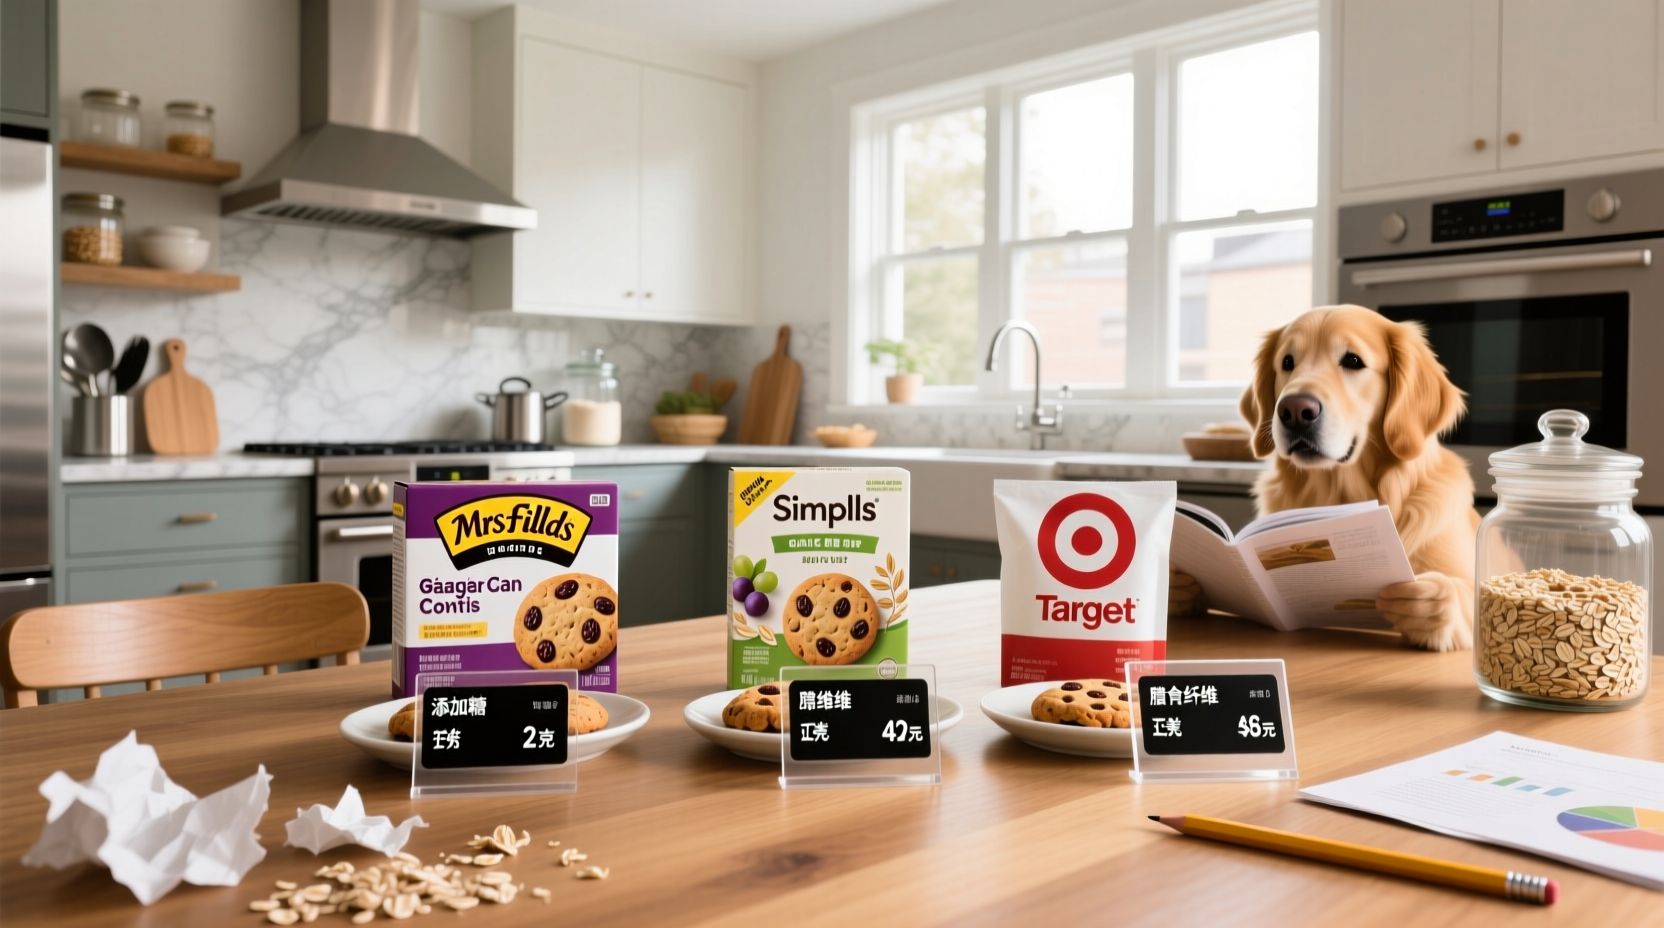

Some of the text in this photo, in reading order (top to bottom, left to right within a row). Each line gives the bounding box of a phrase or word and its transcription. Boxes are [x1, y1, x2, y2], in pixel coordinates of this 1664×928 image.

[487, 576, 522, 593] Can
[1035, 594, 1136, 630] Target
[522, 725, 555, 749] 2克
